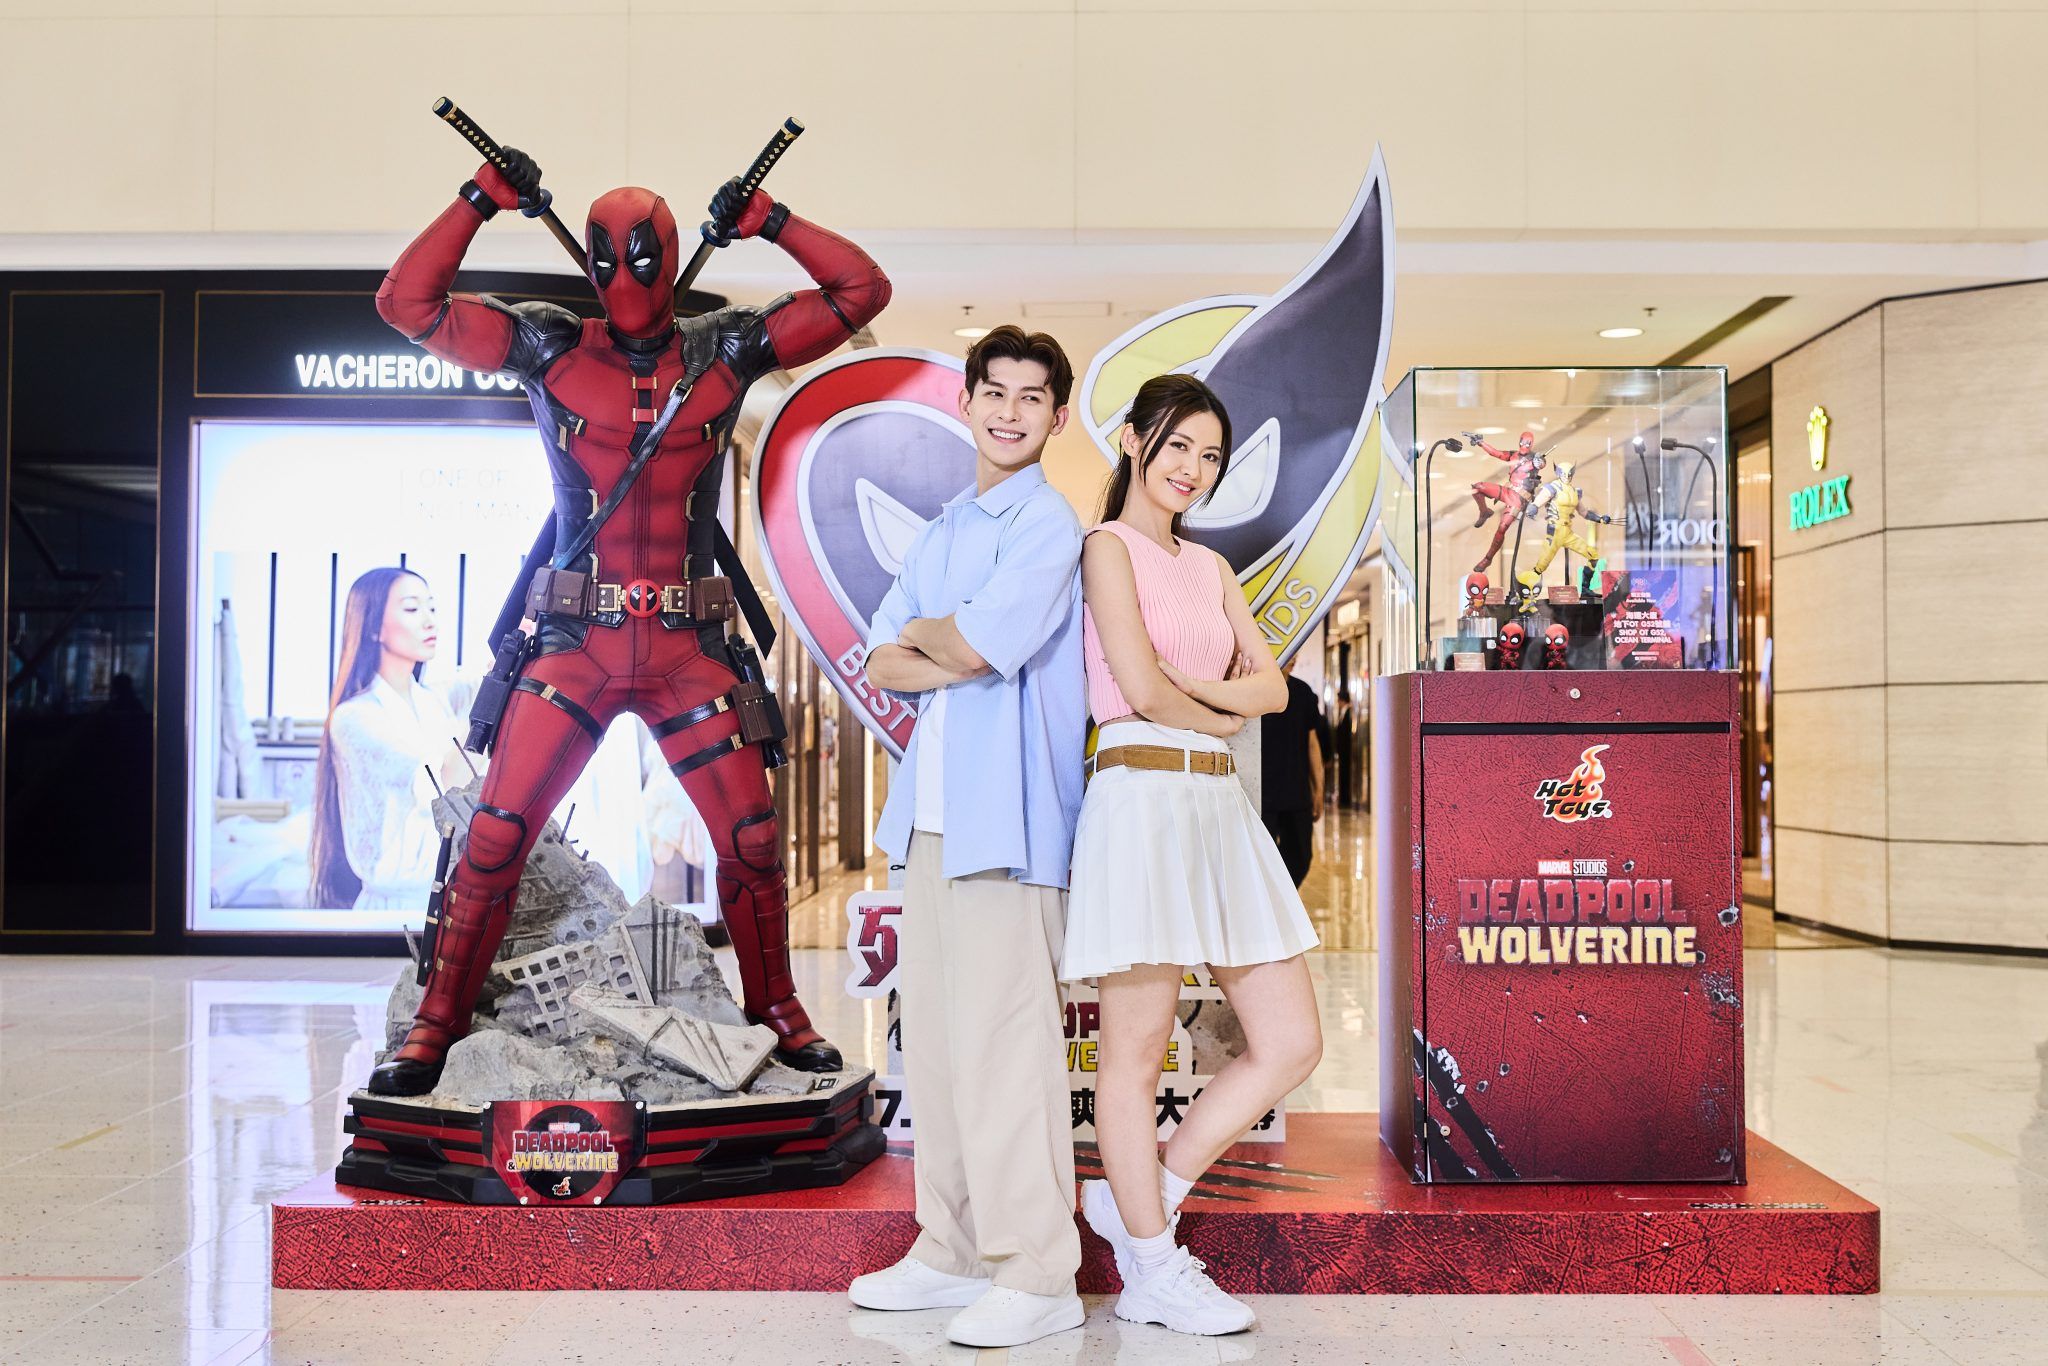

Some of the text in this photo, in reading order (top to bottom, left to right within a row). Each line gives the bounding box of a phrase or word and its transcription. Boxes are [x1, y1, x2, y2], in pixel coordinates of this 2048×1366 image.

[295, 354, 462, 389] VACHERON
[1789, 474, 1850, 531] ROLEX
[1257, 578, 1318, 645] NDS
[1536, 779, 1587, 797] Hot
[1545, 799, 1608, 818] Toys
[1538, 859, 1608, 876] MARVEL STUDIOS
[1458, 879, 1688, 923] DEADPOOL
[1457, 926, 1697, 965] WOLVERINE
[513, 1131, 615, 1153] DEADPOOL
[514, 1153, 619, 1171] WOLVERINE
